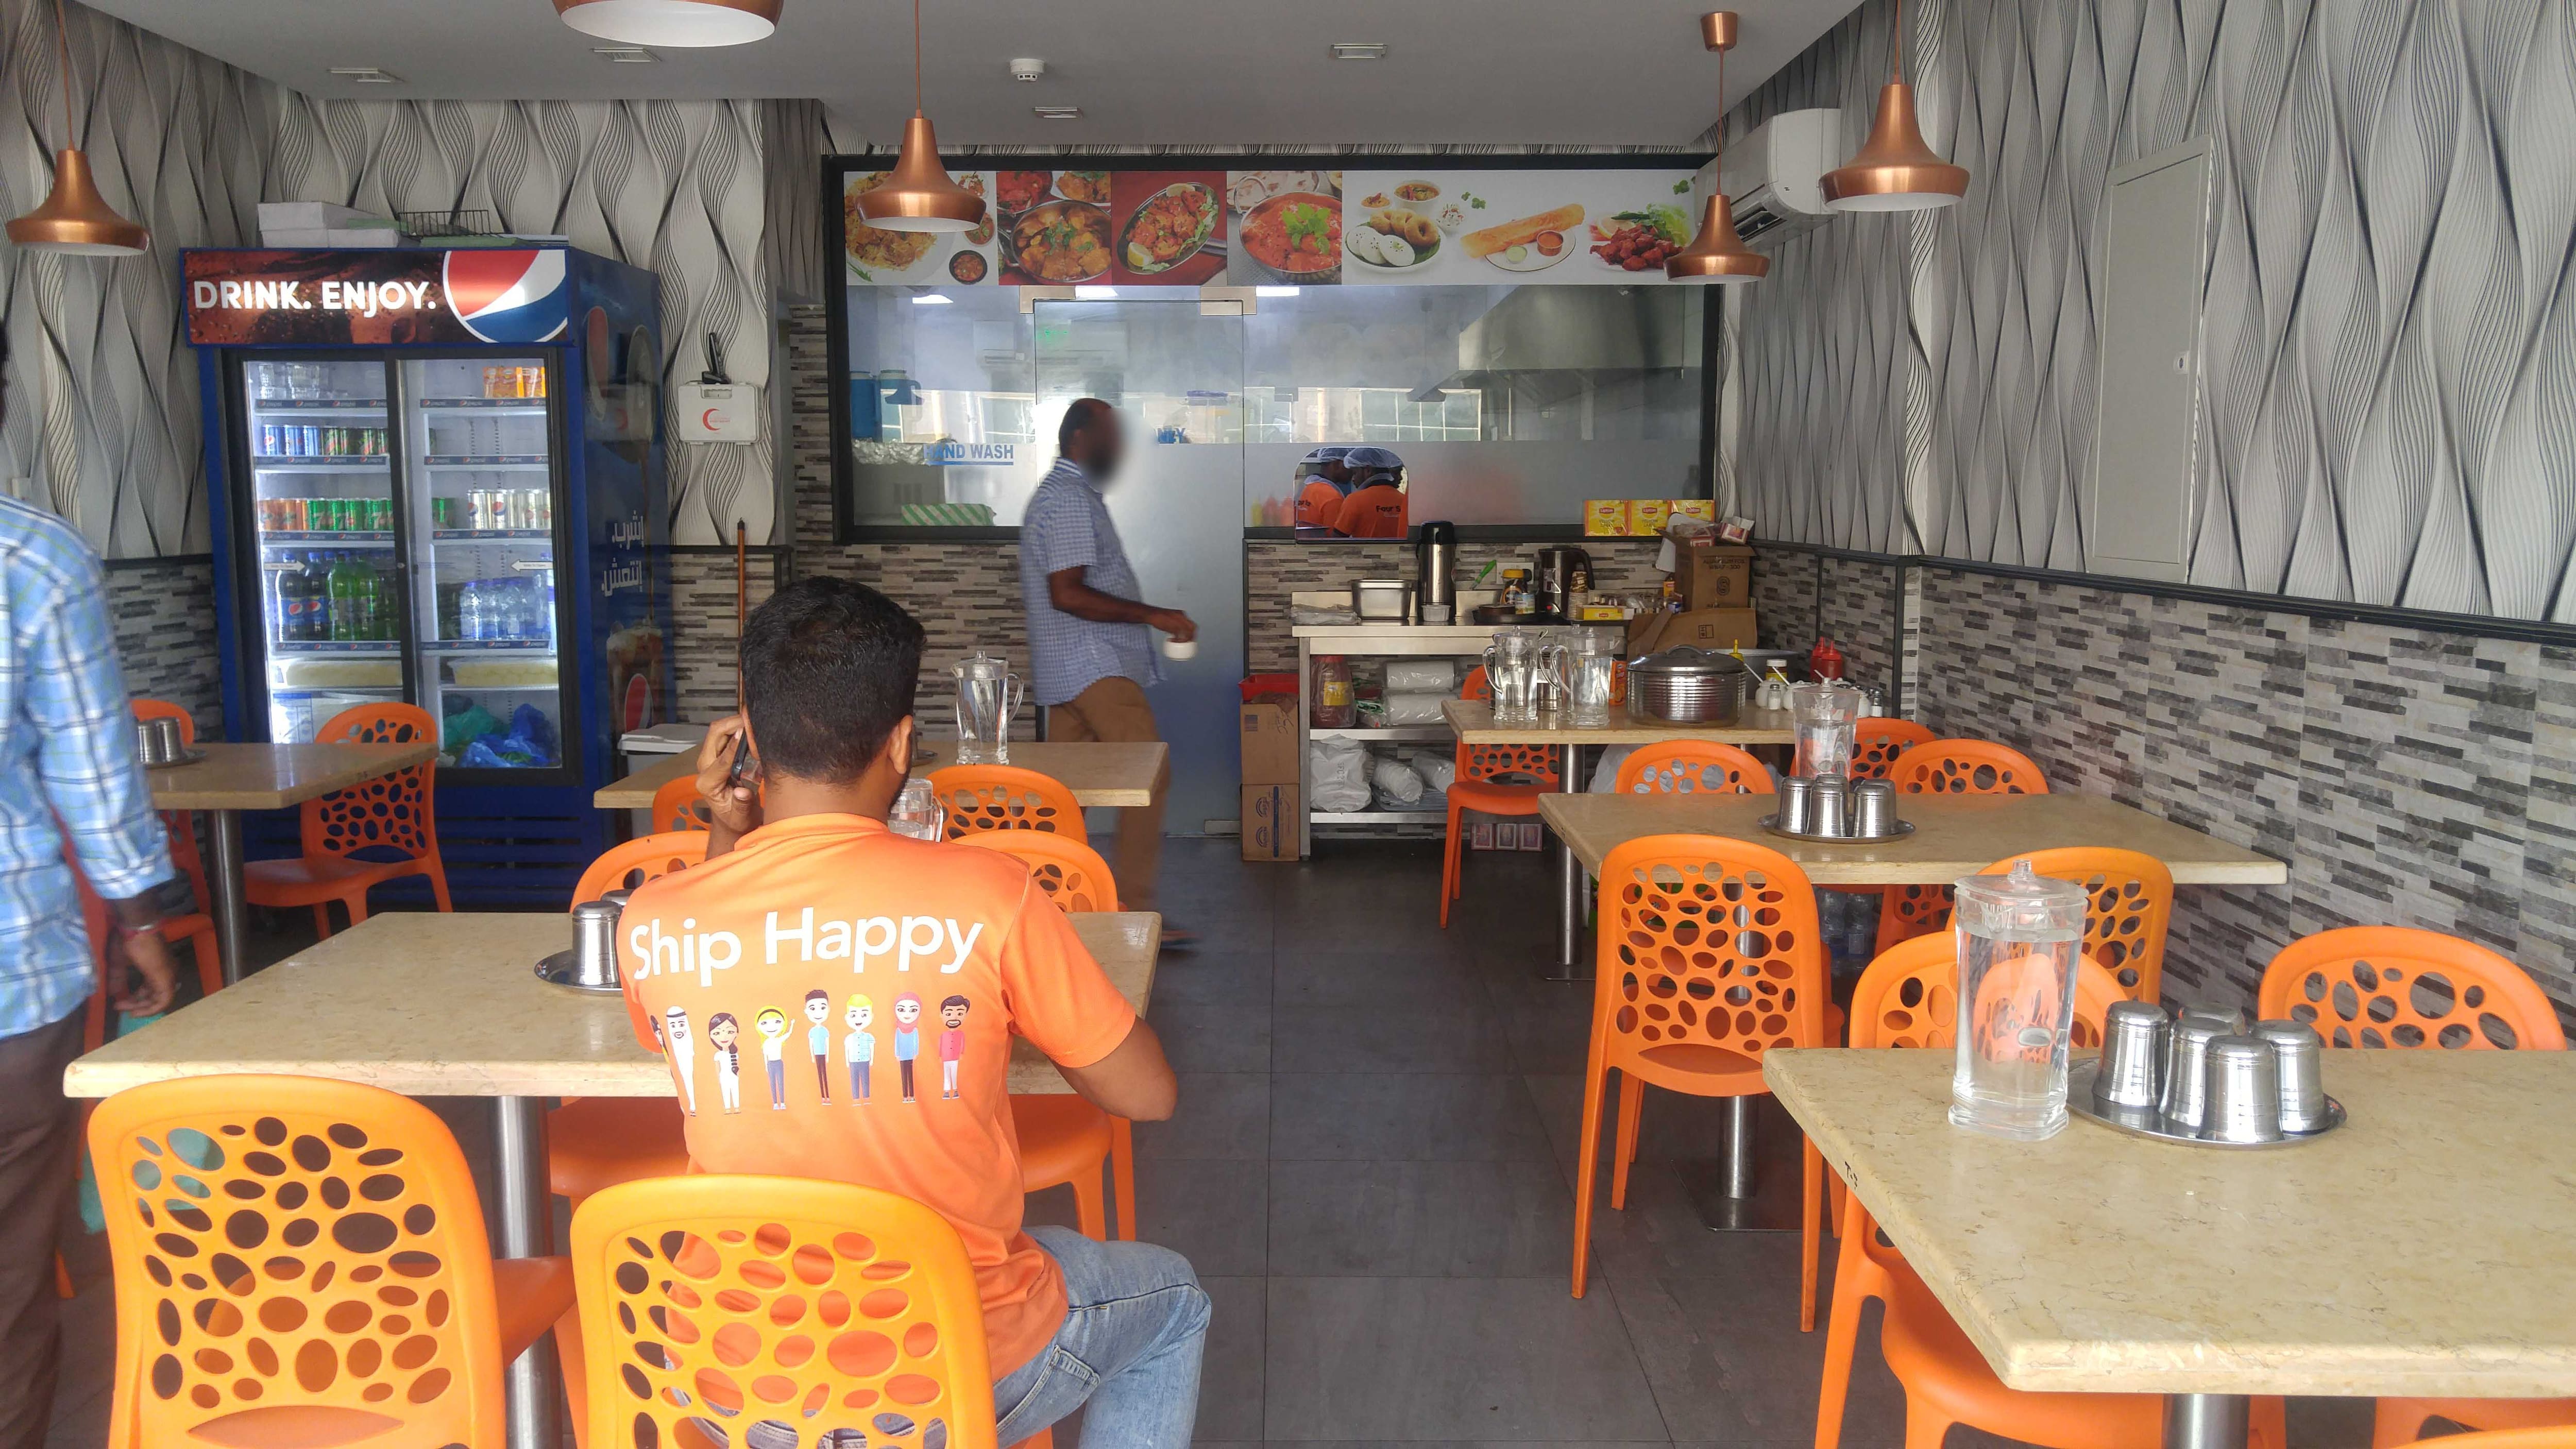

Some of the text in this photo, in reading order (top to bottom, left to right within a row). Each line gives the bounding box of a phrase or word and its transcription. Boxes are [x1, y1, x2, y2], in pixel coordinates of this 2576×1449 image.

[194, 280, 436, 317] DRINK. ENJOY.
[923, 444, 1014, 459] HAND WASH
[630, 907, 984, 987] Ship Happy
